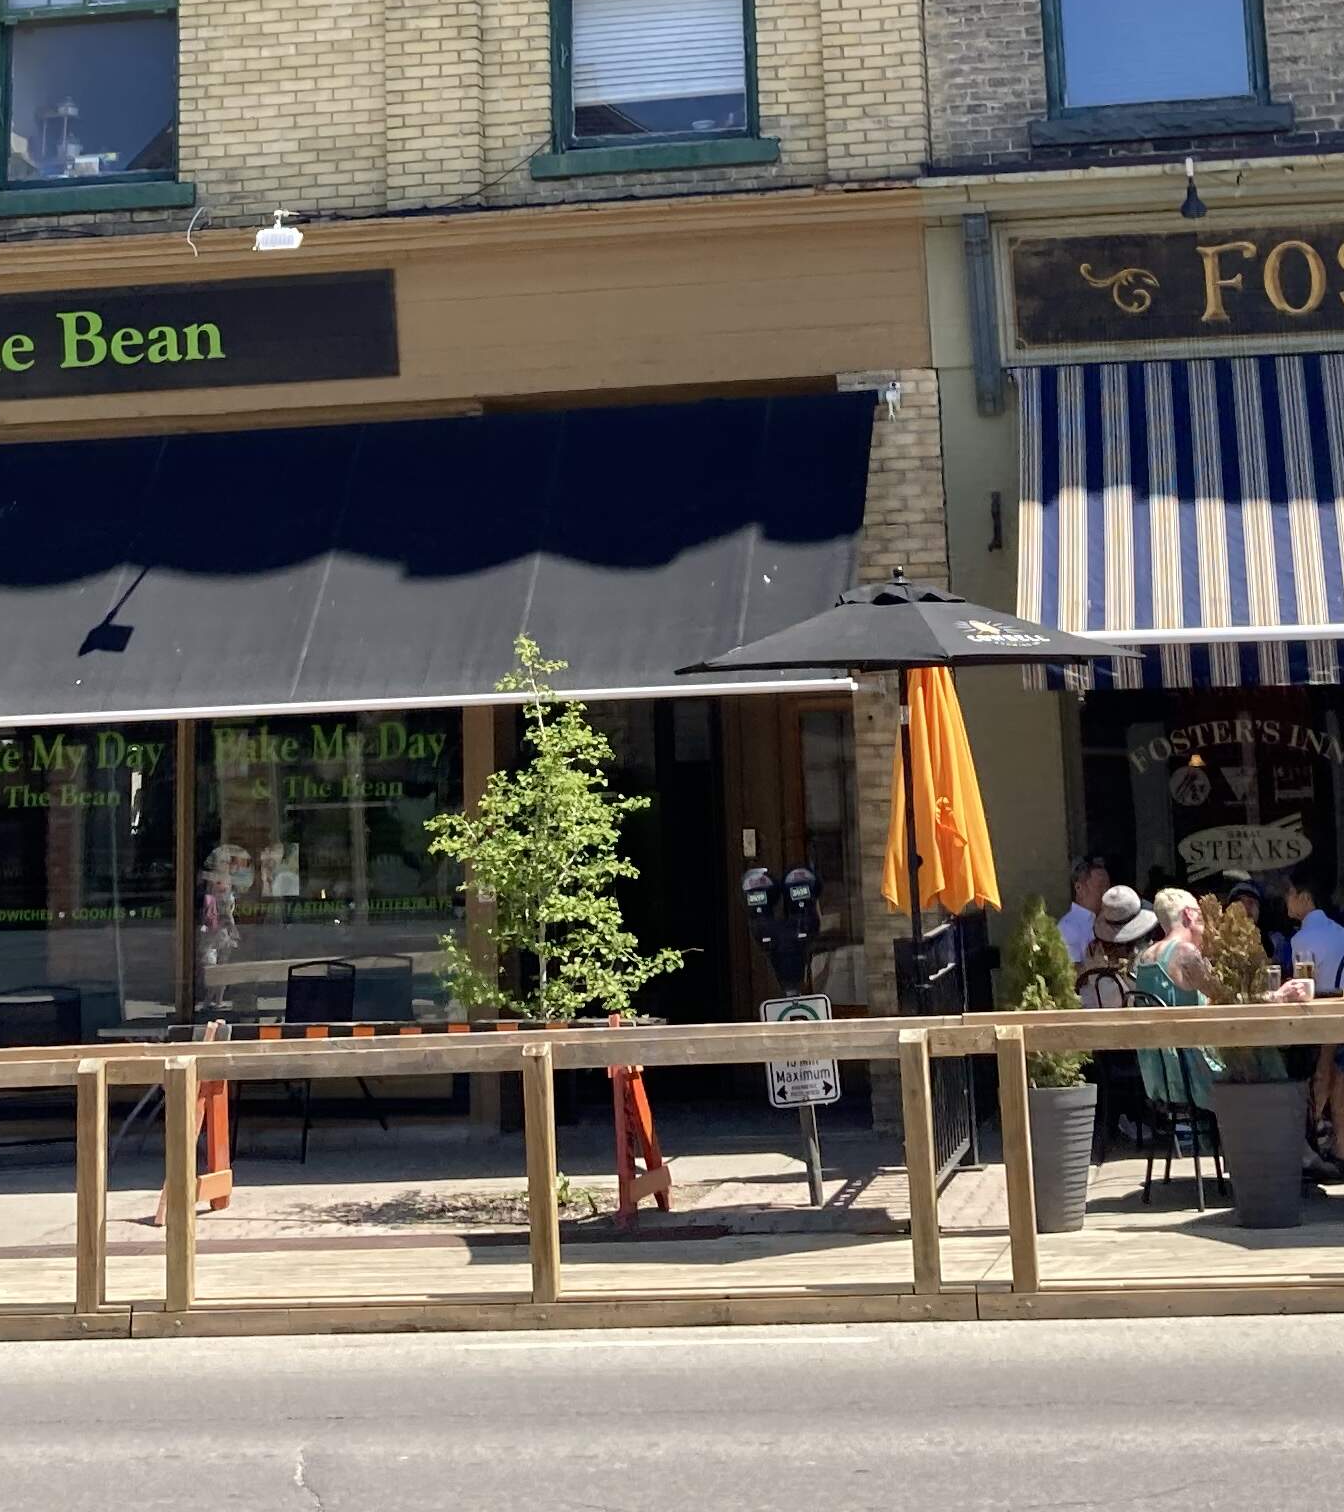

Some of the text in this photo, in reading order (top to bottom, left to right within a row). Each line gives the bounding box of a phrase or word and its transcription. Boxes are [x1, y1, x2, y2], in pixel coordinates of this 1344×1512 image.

[58, 309, 225, 369] Bean
[32, 733, 87, 778] My
[97, 730, 165, 776] Day
[311, 723, 365, 767] My
[378, 721, 447, 768] Day
[1129, 719, 1281, 775] FOSTER'S
[8, 784, 50, 808] The
[60, 784, 122, 807] Bean
[284, 775, 331, 799] The
[342, 774, 404, 797] Bean
[1189, 839, 1302, 861] STEAKS
[141, 905, 161, 919] TEA
[775, 1068, 831, 1084] Maximum
